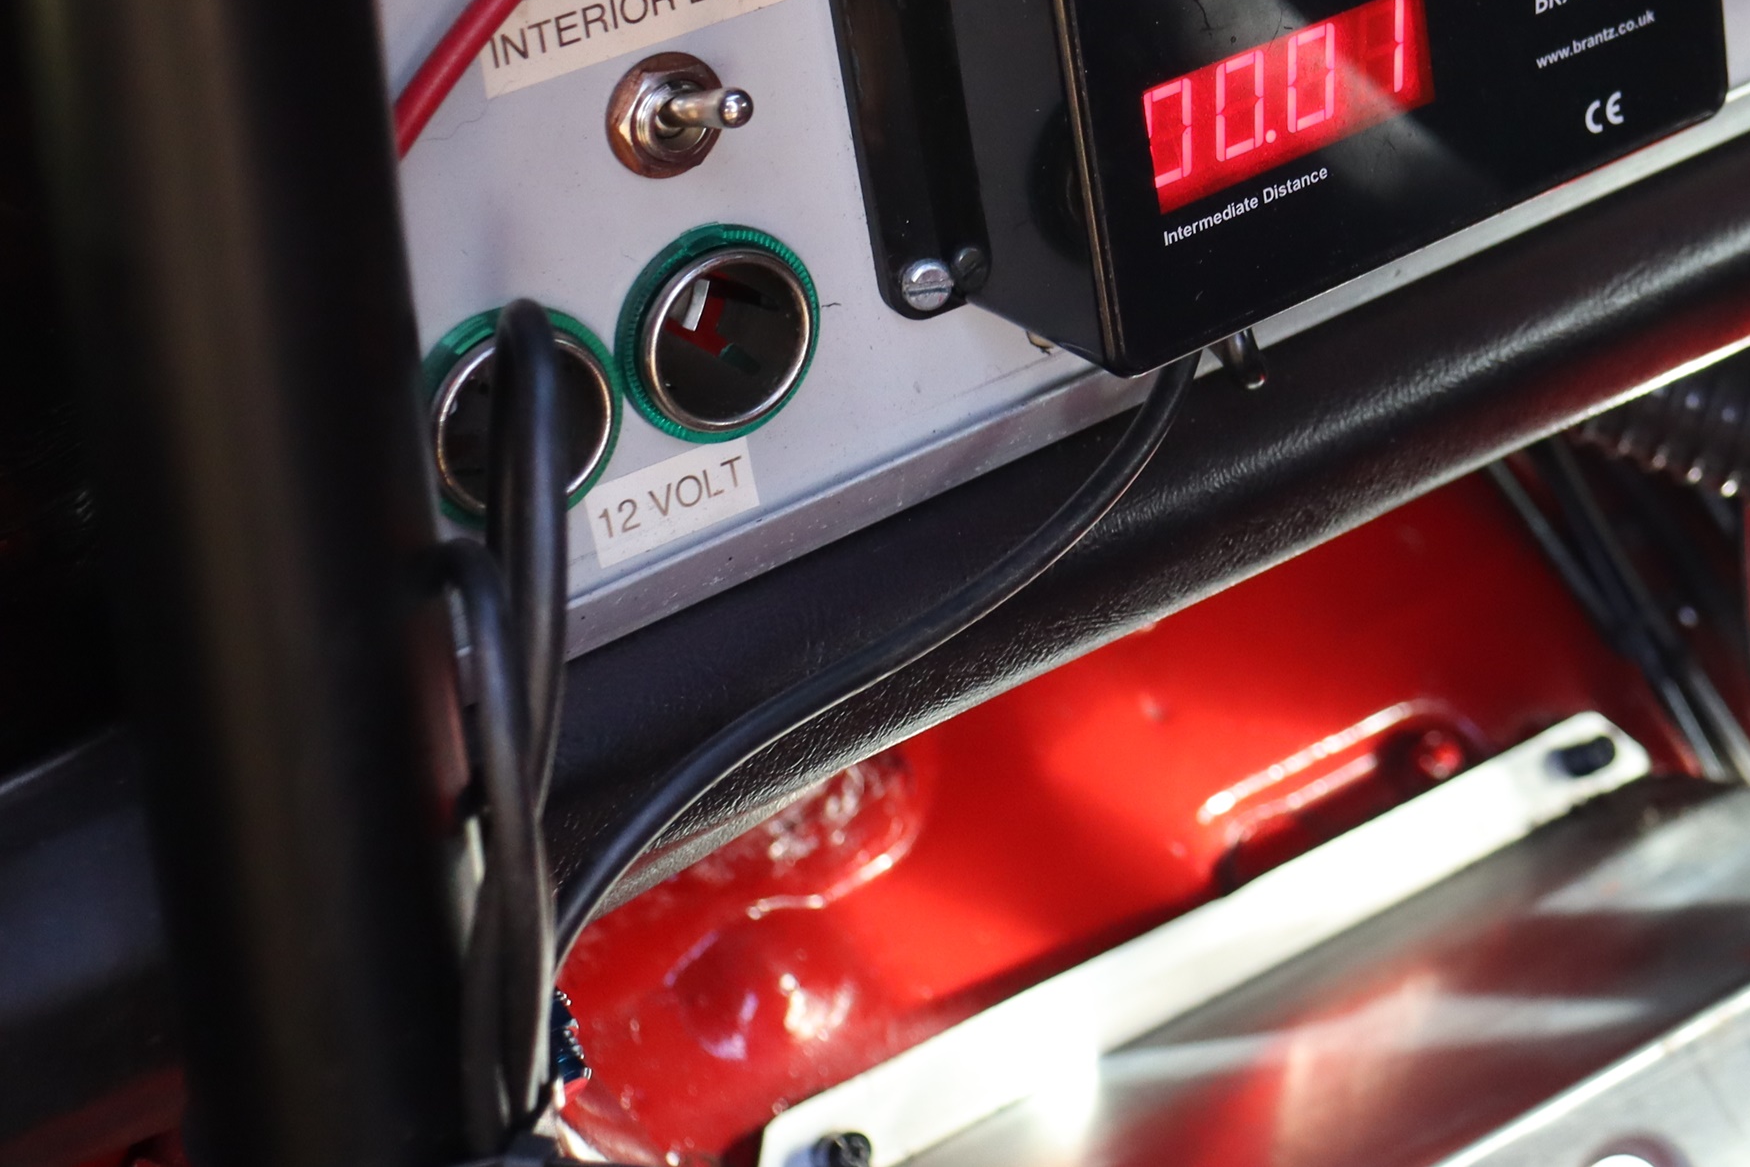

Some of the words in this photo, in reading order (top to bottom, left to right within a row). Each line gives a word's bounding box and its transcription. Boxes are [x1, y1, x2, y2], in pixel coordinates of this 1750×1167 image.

[1535, 9, 1656, 69] www.brantz.co.uk
[1163, 197, 1260, 246] Intermediate
[1262, 167, 1329, 205] Distance
[598, 498, 641, 539] 12
[647, 454, 742, 518] VOLT
